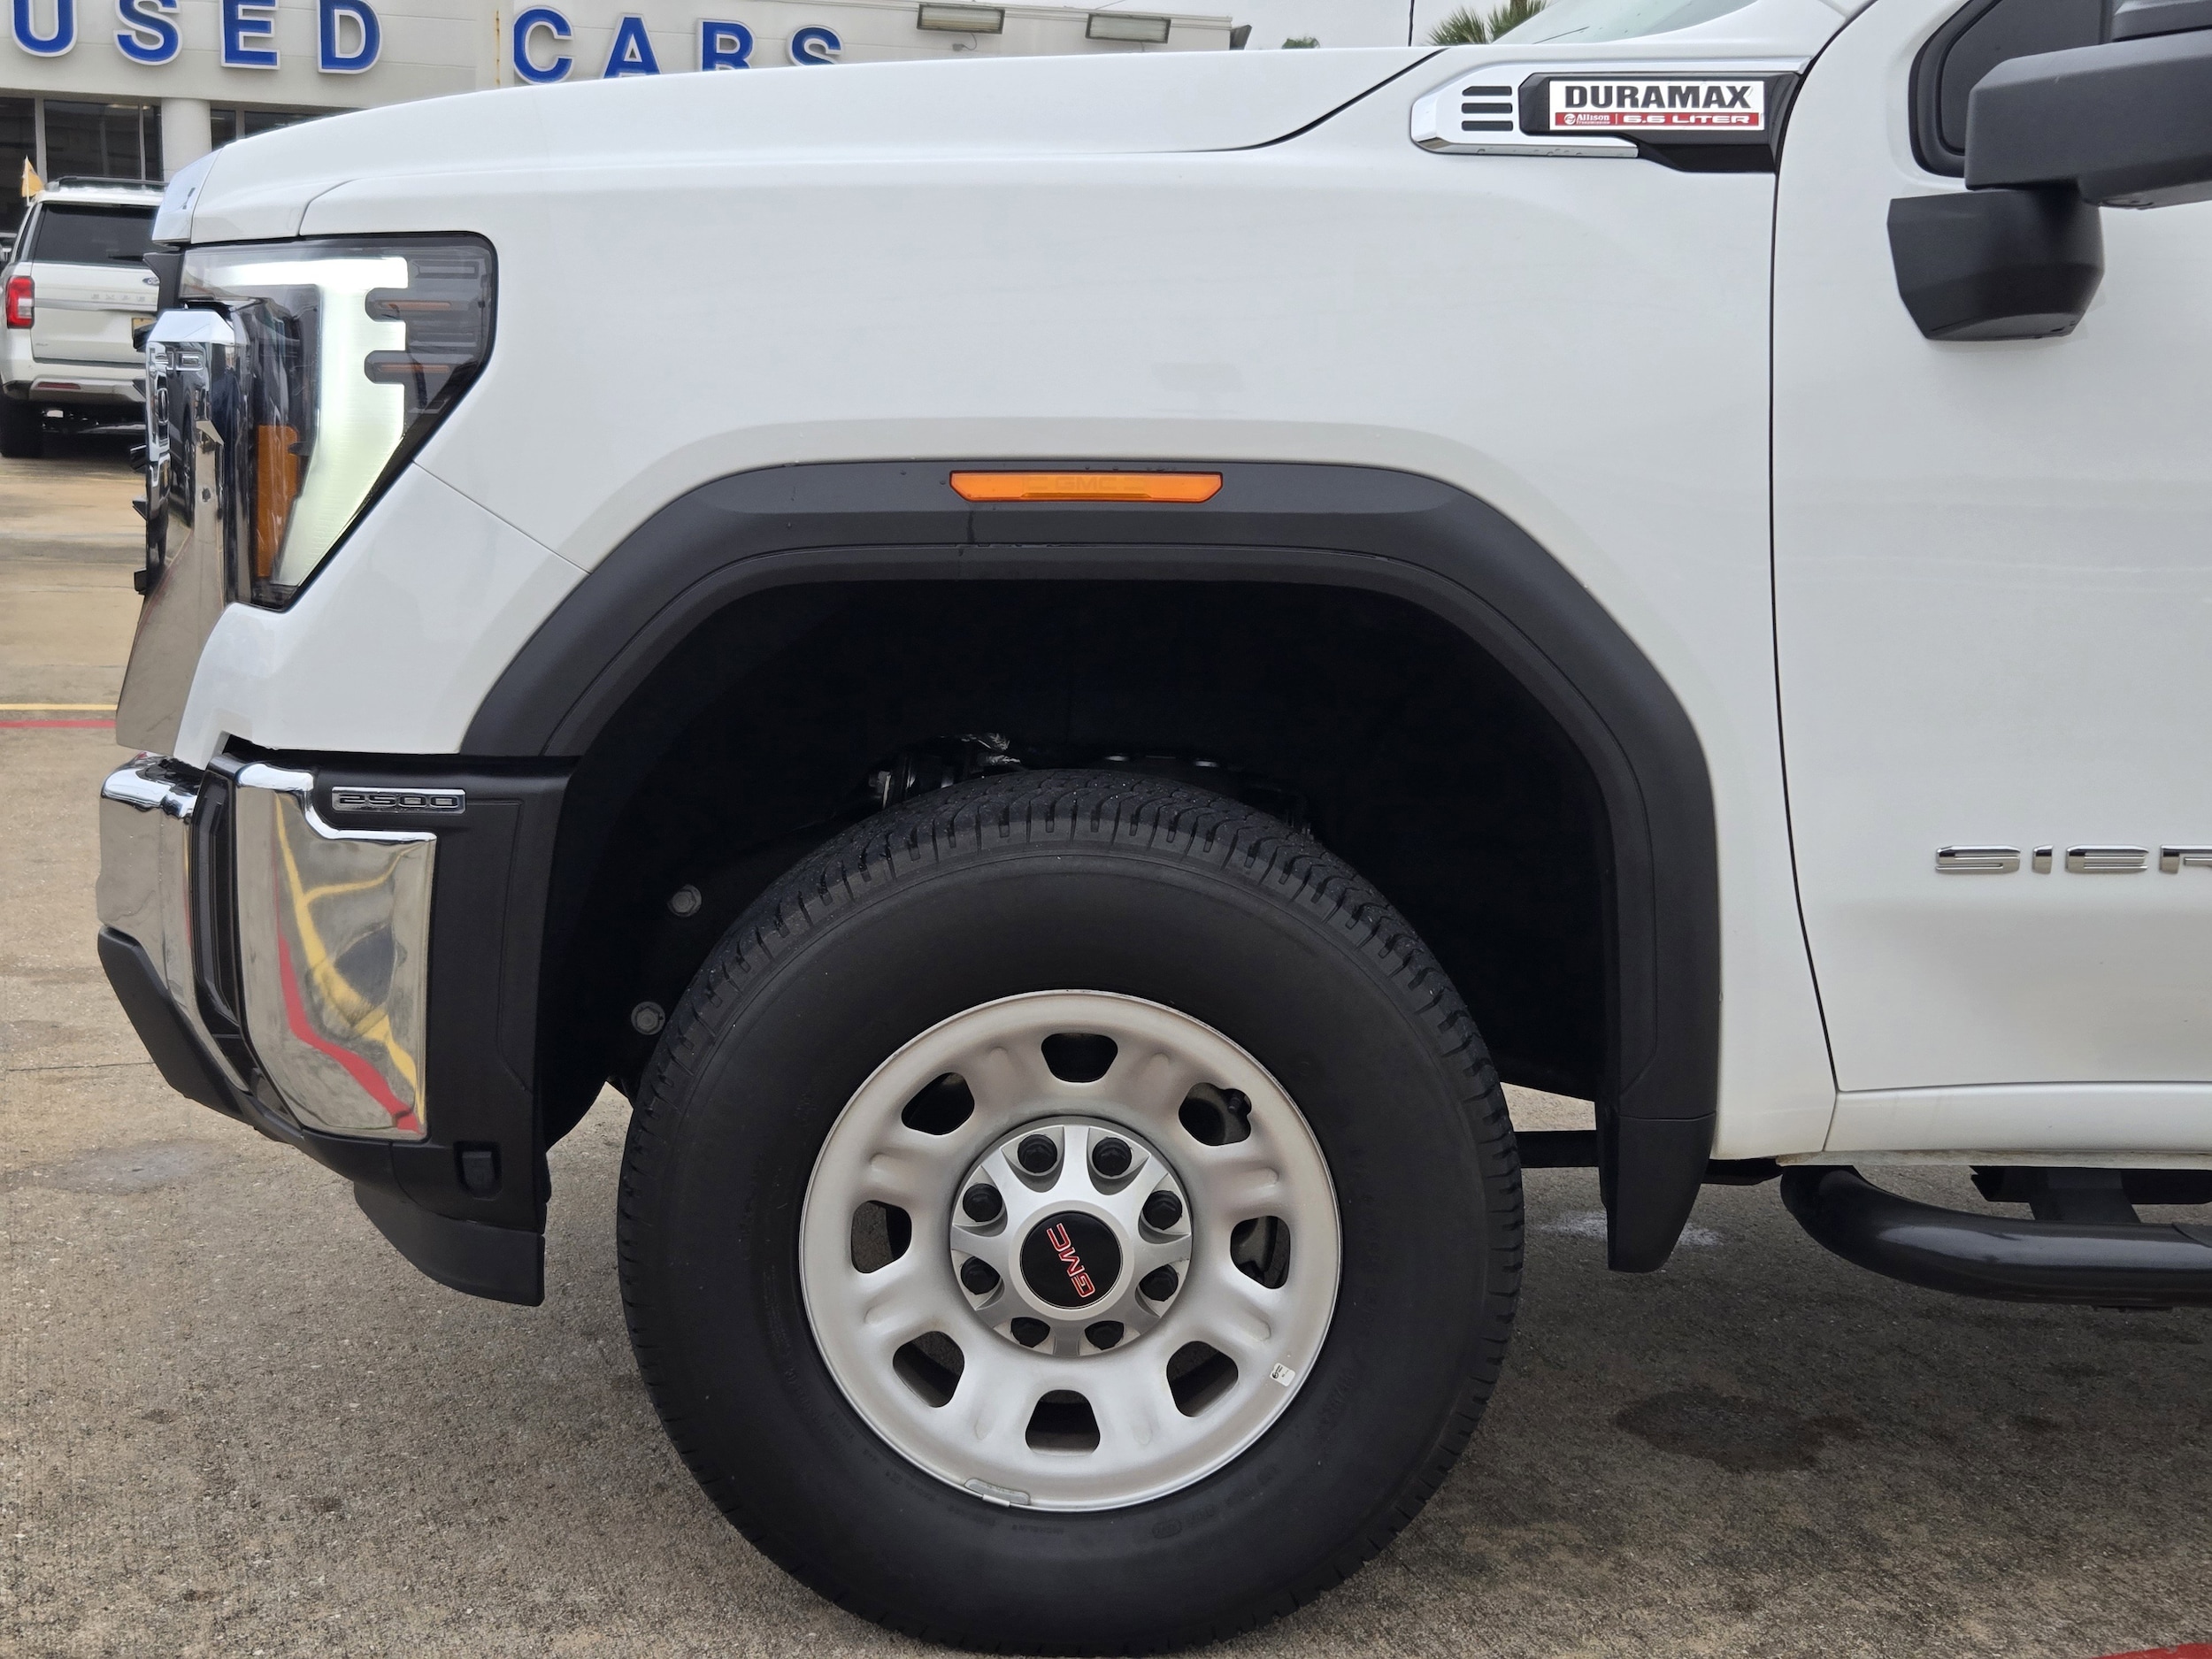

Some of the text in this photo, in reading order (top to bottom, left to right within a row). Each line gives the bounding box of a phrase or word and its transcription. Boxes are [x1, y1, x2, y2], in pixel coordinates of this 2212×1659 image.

[12, 0, 845, 86] USED CARS
[1564, 86, 1752, 109] DURAMAX
[1623, 114, 1665, 124] 6.6
[1671, 114, 1751, 124] LITER
[338, 794, 460, 809] 2500
[1046, 1222, 1096, 1298] GMC
